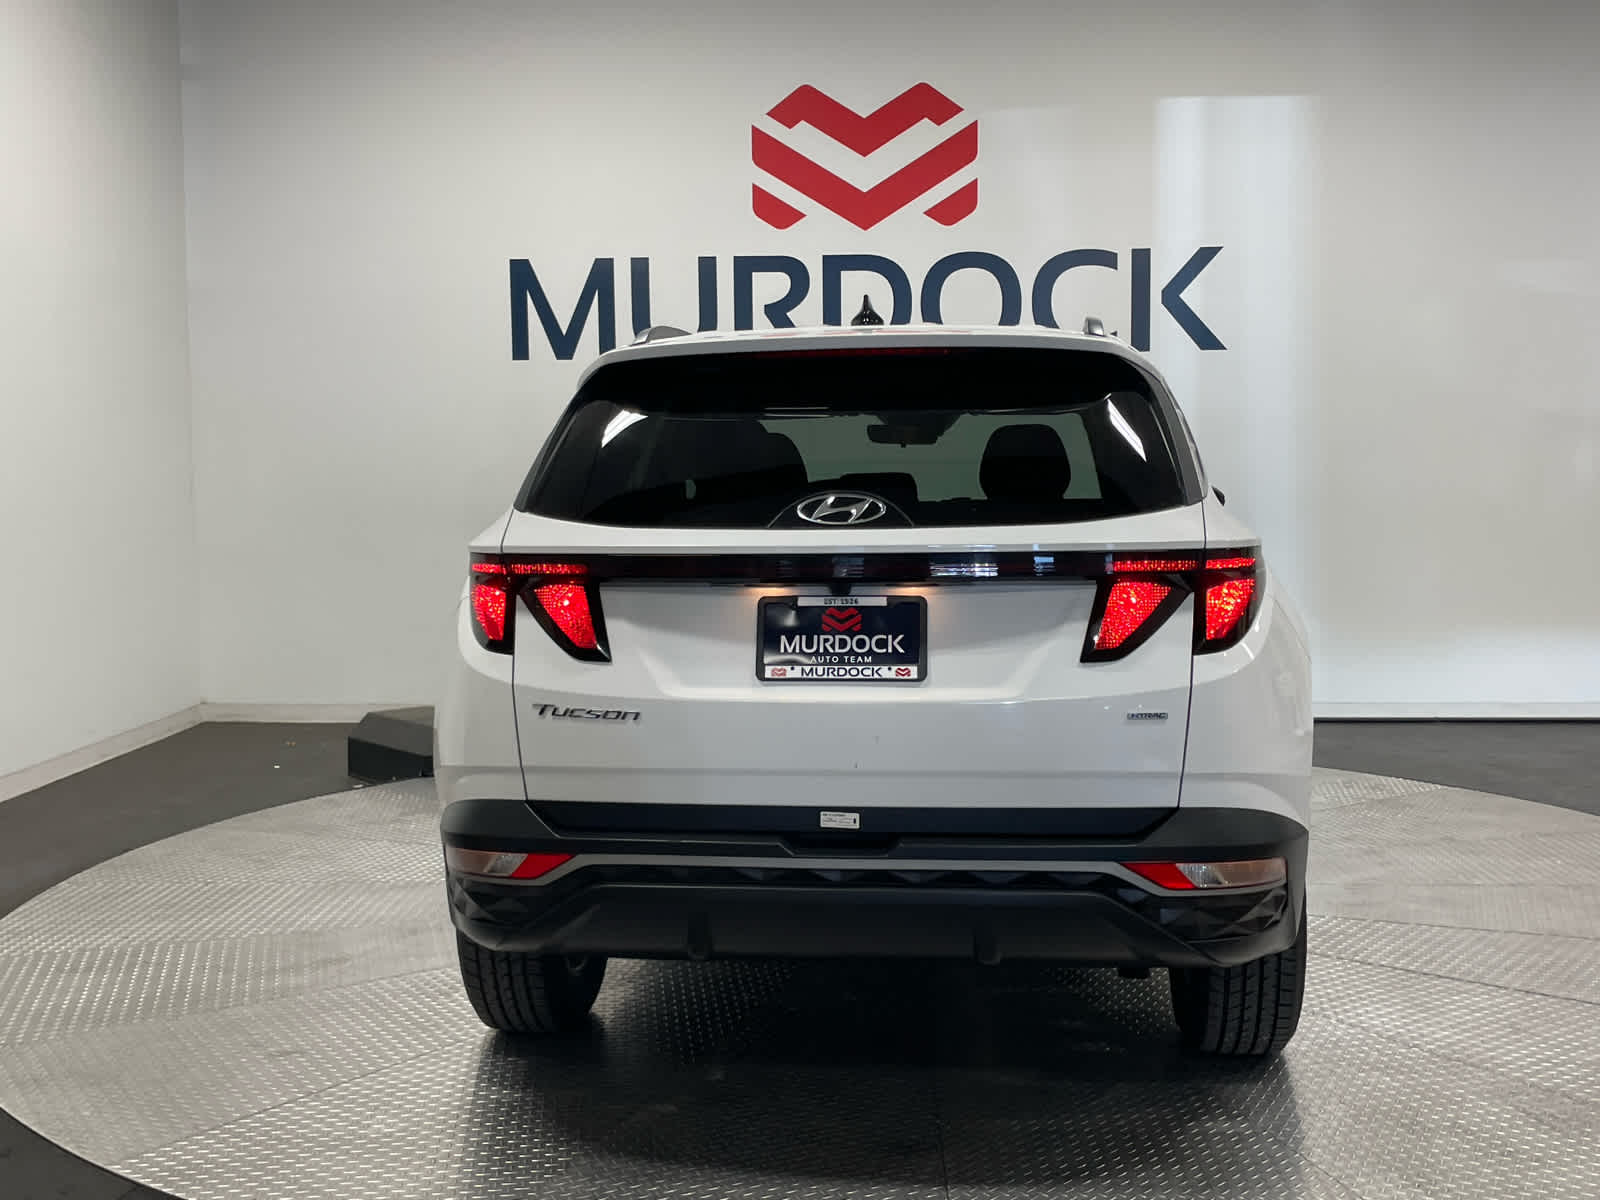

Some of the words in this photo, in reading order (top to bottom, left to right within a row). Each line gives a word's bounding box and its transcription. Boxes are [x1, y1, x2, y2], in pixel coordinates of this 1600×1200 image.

[508, 246, 1228, 361] MURDOCK
[780, 634, 905, 653] MURDOCK
[810, 655, 839, 663] AUTO
[844, 655, 872, 663] TEAM
[801, 667, 882, 677] MURDOCK
